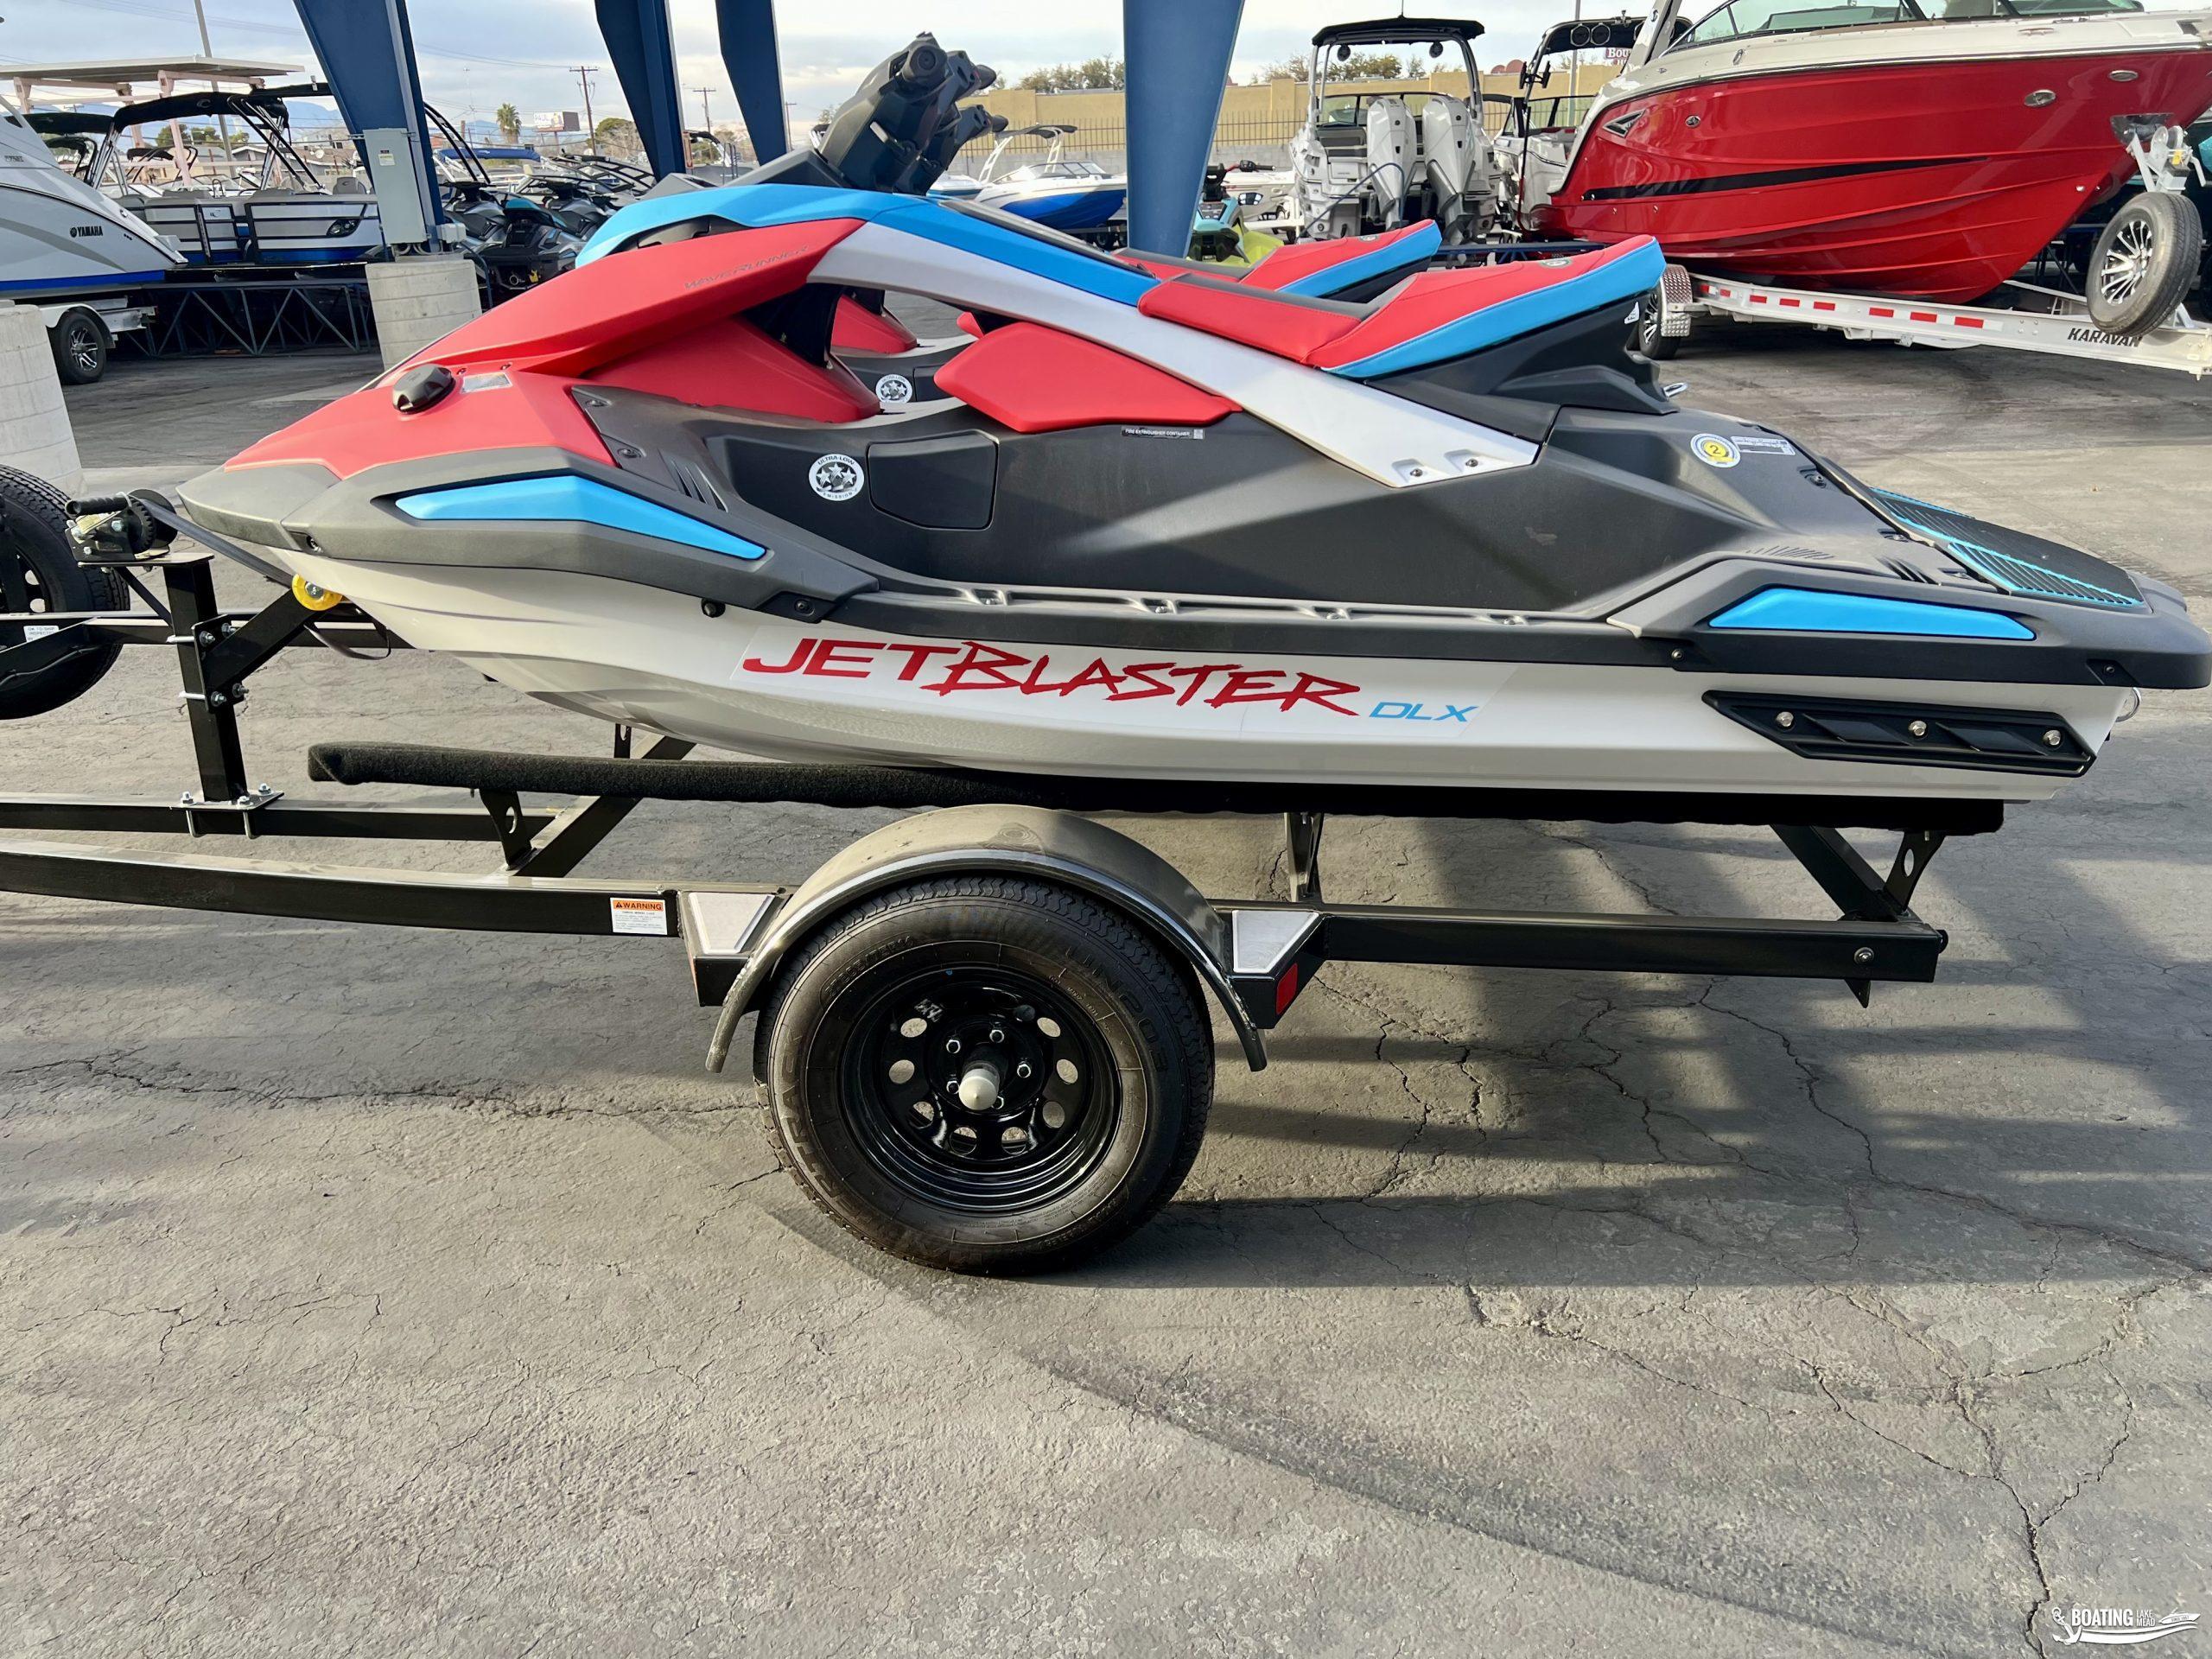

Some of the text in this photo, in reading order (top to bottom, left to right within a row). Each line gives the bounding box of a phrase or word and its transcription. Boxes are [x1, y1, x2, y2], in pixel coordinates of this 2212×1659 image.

[77, 226, 103, 237] YAMAHA
[2068, 327, 2143, 347] KARAVAN
[817, 455, 855, 466] ULTRA-LOW
[1369, 702, 1479, 722] DLX
[622, 902, 662, 911] WARNING
